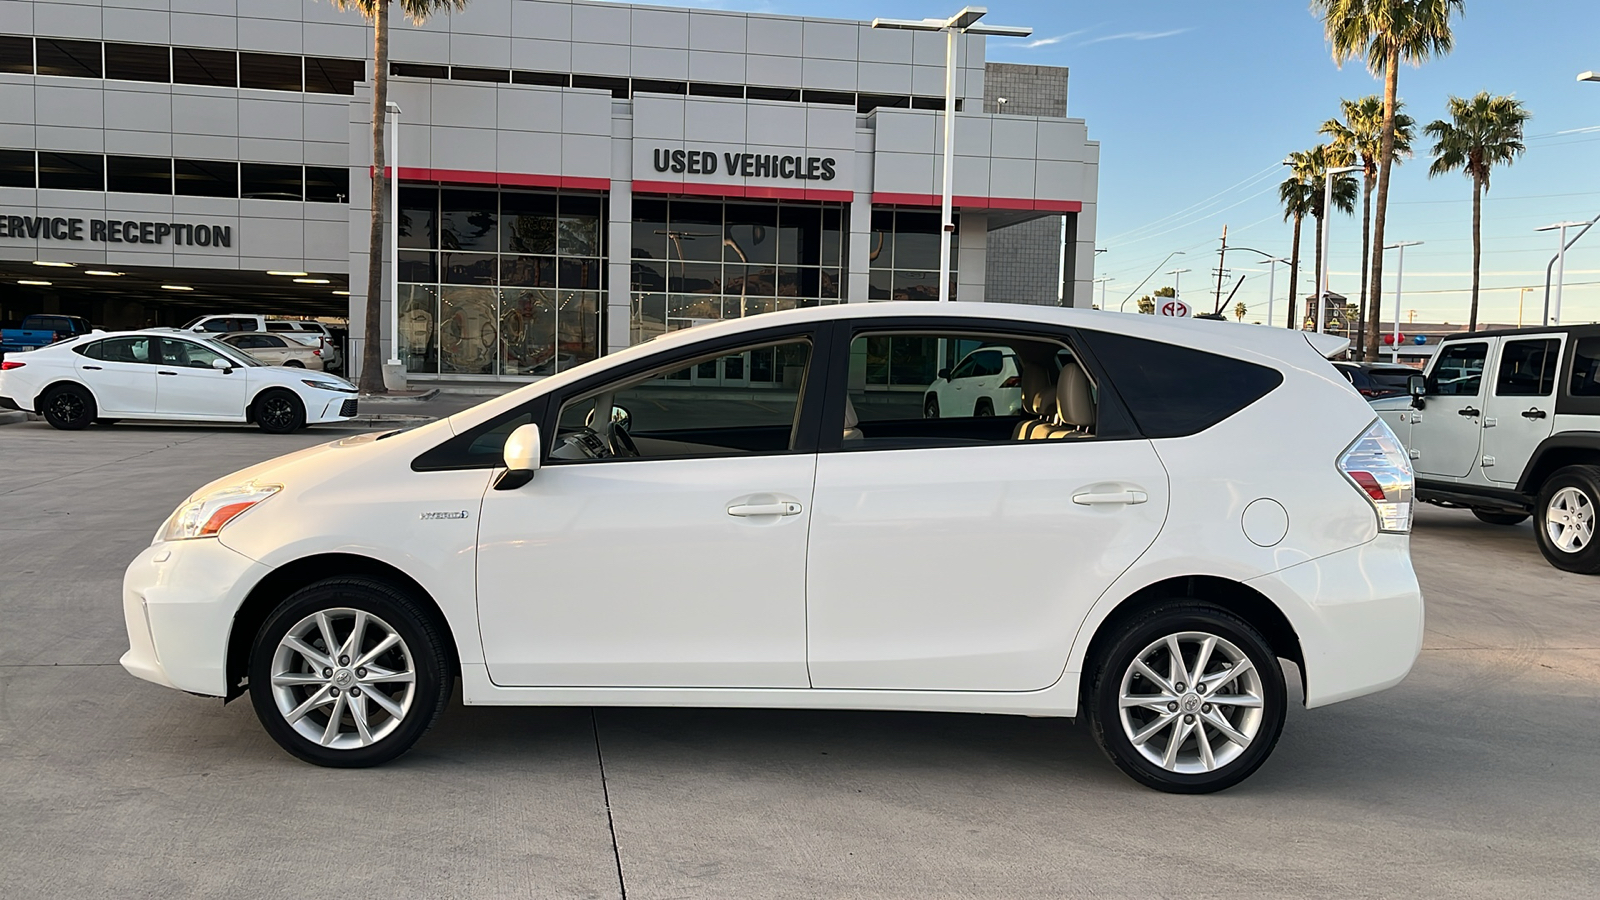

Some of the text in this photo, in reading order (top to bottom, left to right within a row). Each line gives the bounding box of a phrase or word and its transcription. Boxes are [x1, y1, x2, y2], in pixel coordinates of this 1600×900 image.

[653, 148, 836, 181] USED VEHICLES
[90, 219, 231, 247] RECEPTION
